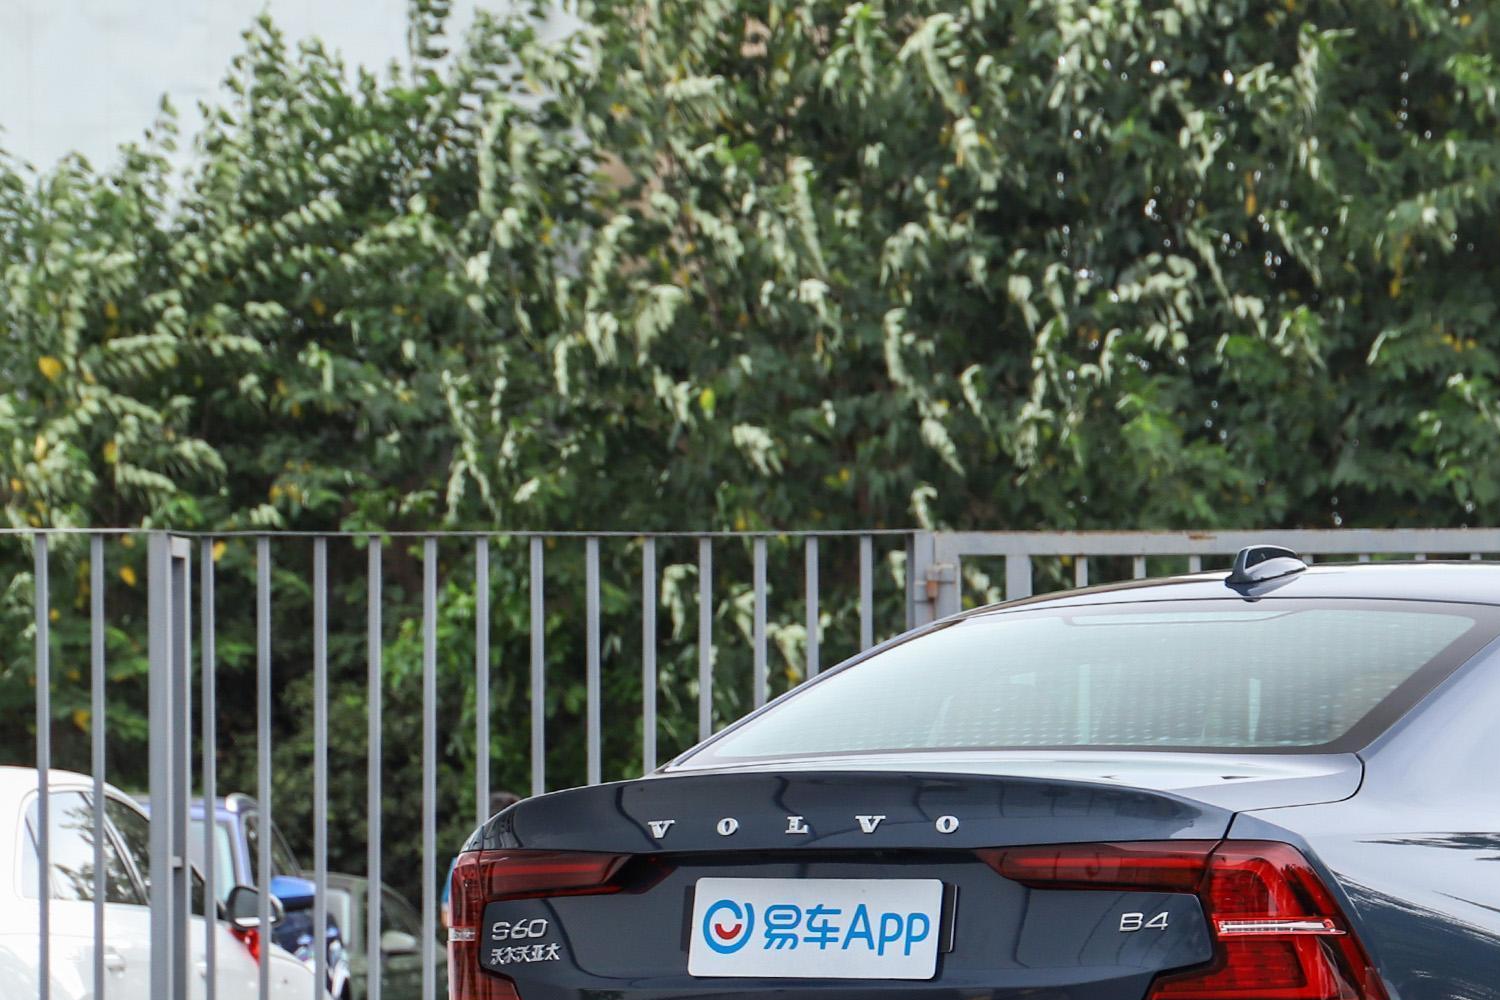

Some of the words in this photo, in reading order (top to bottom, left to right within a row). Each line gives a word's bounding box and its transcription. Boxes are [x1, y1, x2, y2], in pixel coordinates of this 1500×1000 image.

[647, 814, 961, 840] VOLVO
[491, 918, 549, 941] S60
[763, 903, 931, 957] 易车App
[1119, 911, 1169, 932] B4
[489, 942, 562, 966] 沃尔沃亚太
